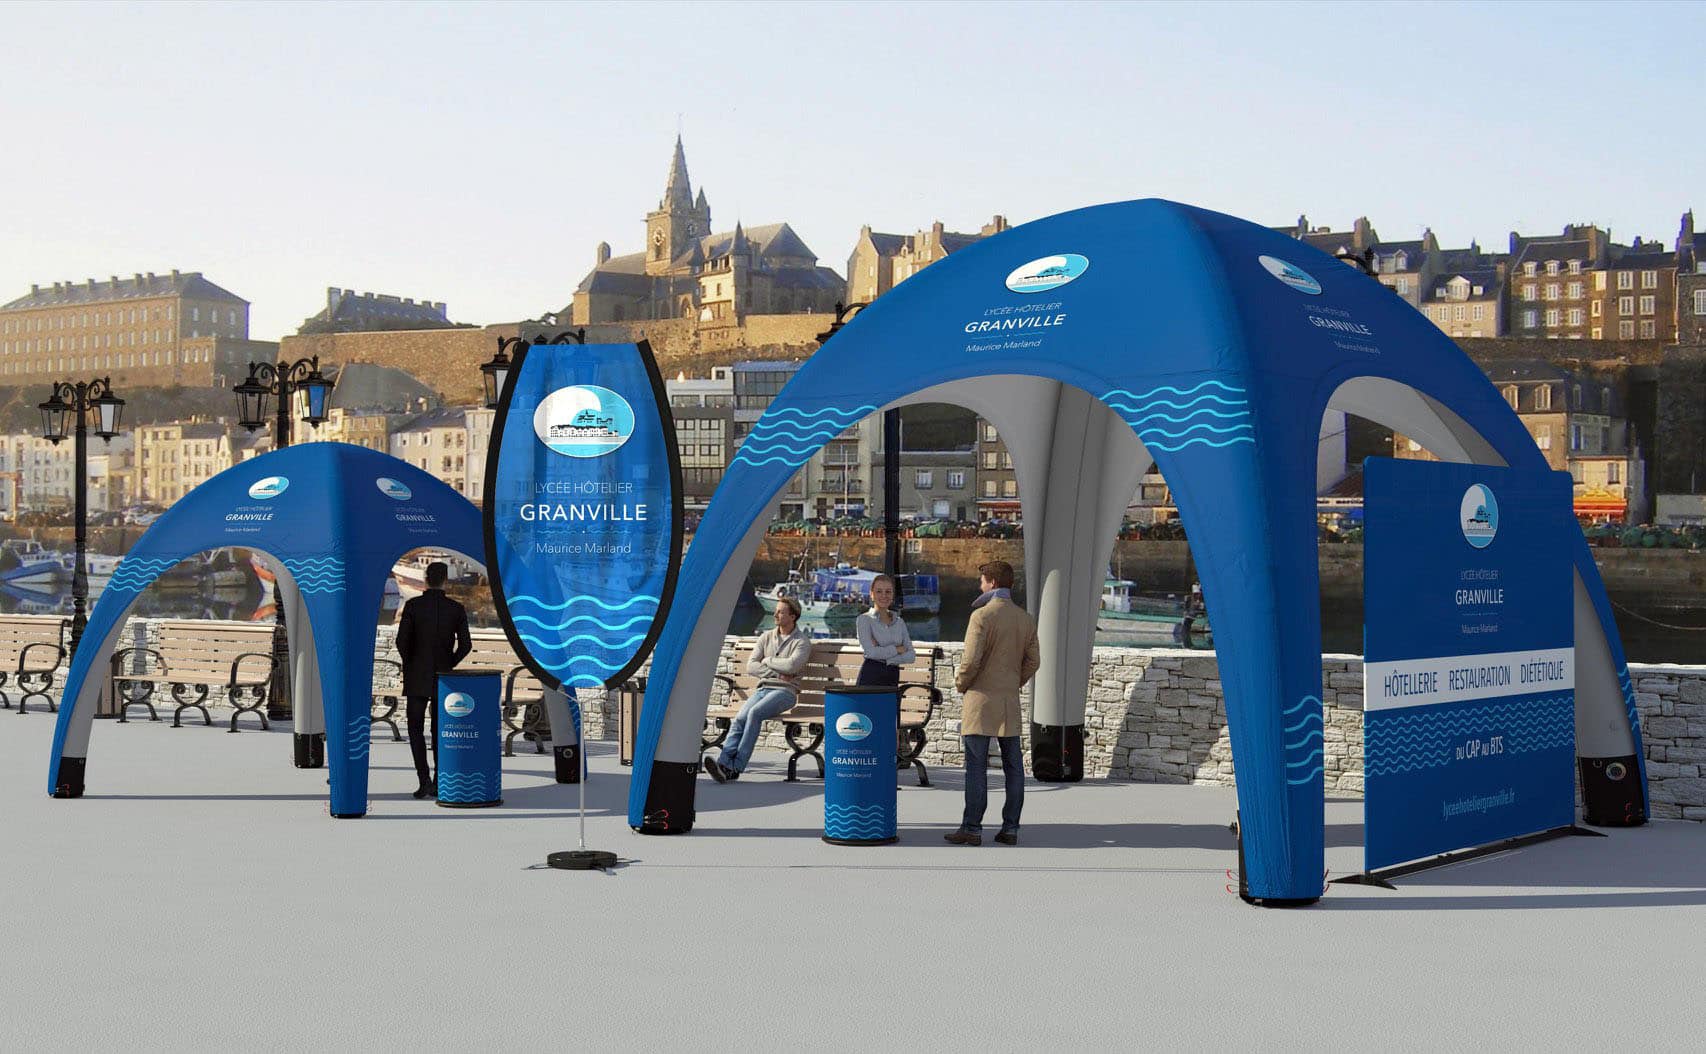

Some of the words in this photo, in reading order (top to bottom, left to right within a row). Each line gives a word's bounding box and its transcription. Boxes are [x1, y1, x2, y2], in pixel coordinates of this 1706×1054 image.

[964, 313, 1067, 333] GRANVILLE
[1308, 315, 1373, 336] GRANVILLE
[965, 344, 1001, 353] Maurice
[1003, 339, 1042, 350] Marland
[535, 480, 571, 495] LYCÉE
[574, 480, 633, 494] HÔTELIER
[225, 512, 274, 521] GRANVILLE
[395, 513, 436, 522] GRANVILLE
[519, 503, 648, 521] GRANVILLE
[536, 542, 582, 554] Maurice
[584, 542, 632, 554] Marland
[1455, 588, 1504, 605] GRANVILLE
[1384, 669, 1438, 698] HÔTELLERIE
[1449, 665, 1511, 691] RESTAURATION
[1520, 657, 1564, 684] DIÉTÉTIQUE
[442, 730, 479, 739] GRANVILLE
[1456, 746, 1465, 760] DU
[1465, 739, 1481, 759] CAP
[1490, 735, 1504, 755] BTS
[831, 756, 878, 766] GRANVILLE
